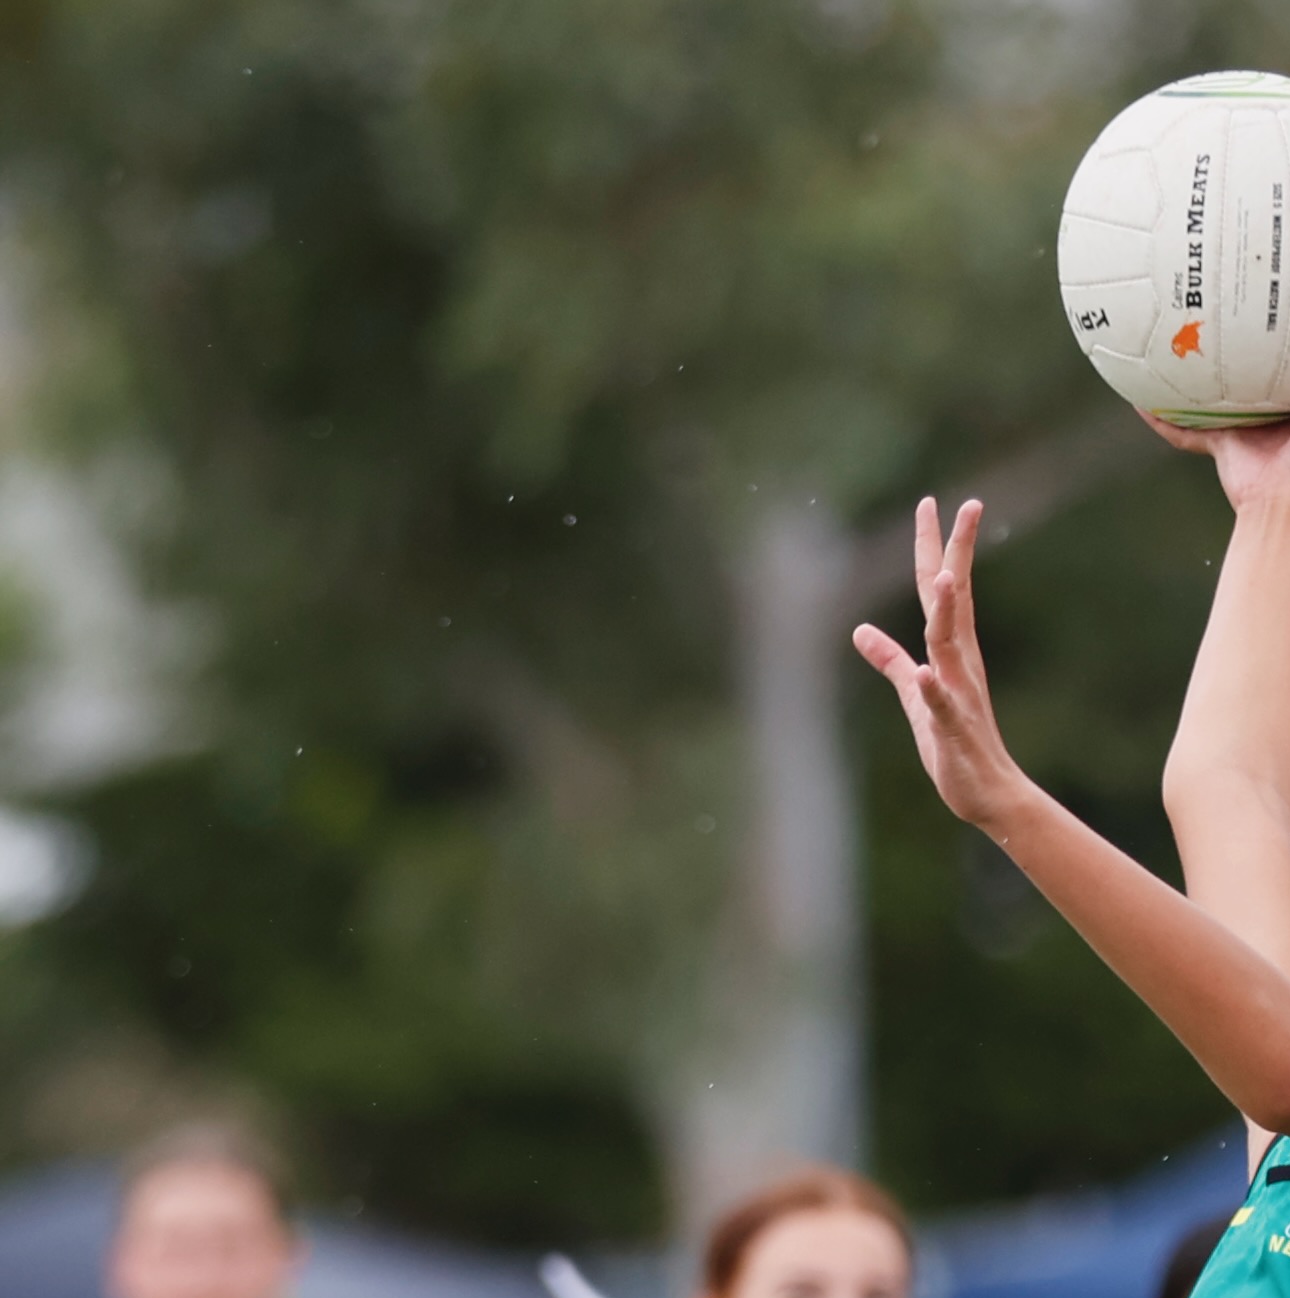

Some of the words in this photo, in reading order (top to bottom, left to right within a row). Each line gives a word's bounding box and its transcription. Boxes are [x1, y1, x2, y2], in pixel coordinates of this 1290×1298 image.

[1187, 153, 1211, 235] MEATS
[1271, 215, 1282, 274] WATERPROOF
[1171, 271, 1184, 311] Cairns
[1185, 242, 1203, 310] BULK
[1268, 280, 1280, 310] MATCH
[1266, 312, 1278, 332] BALL
